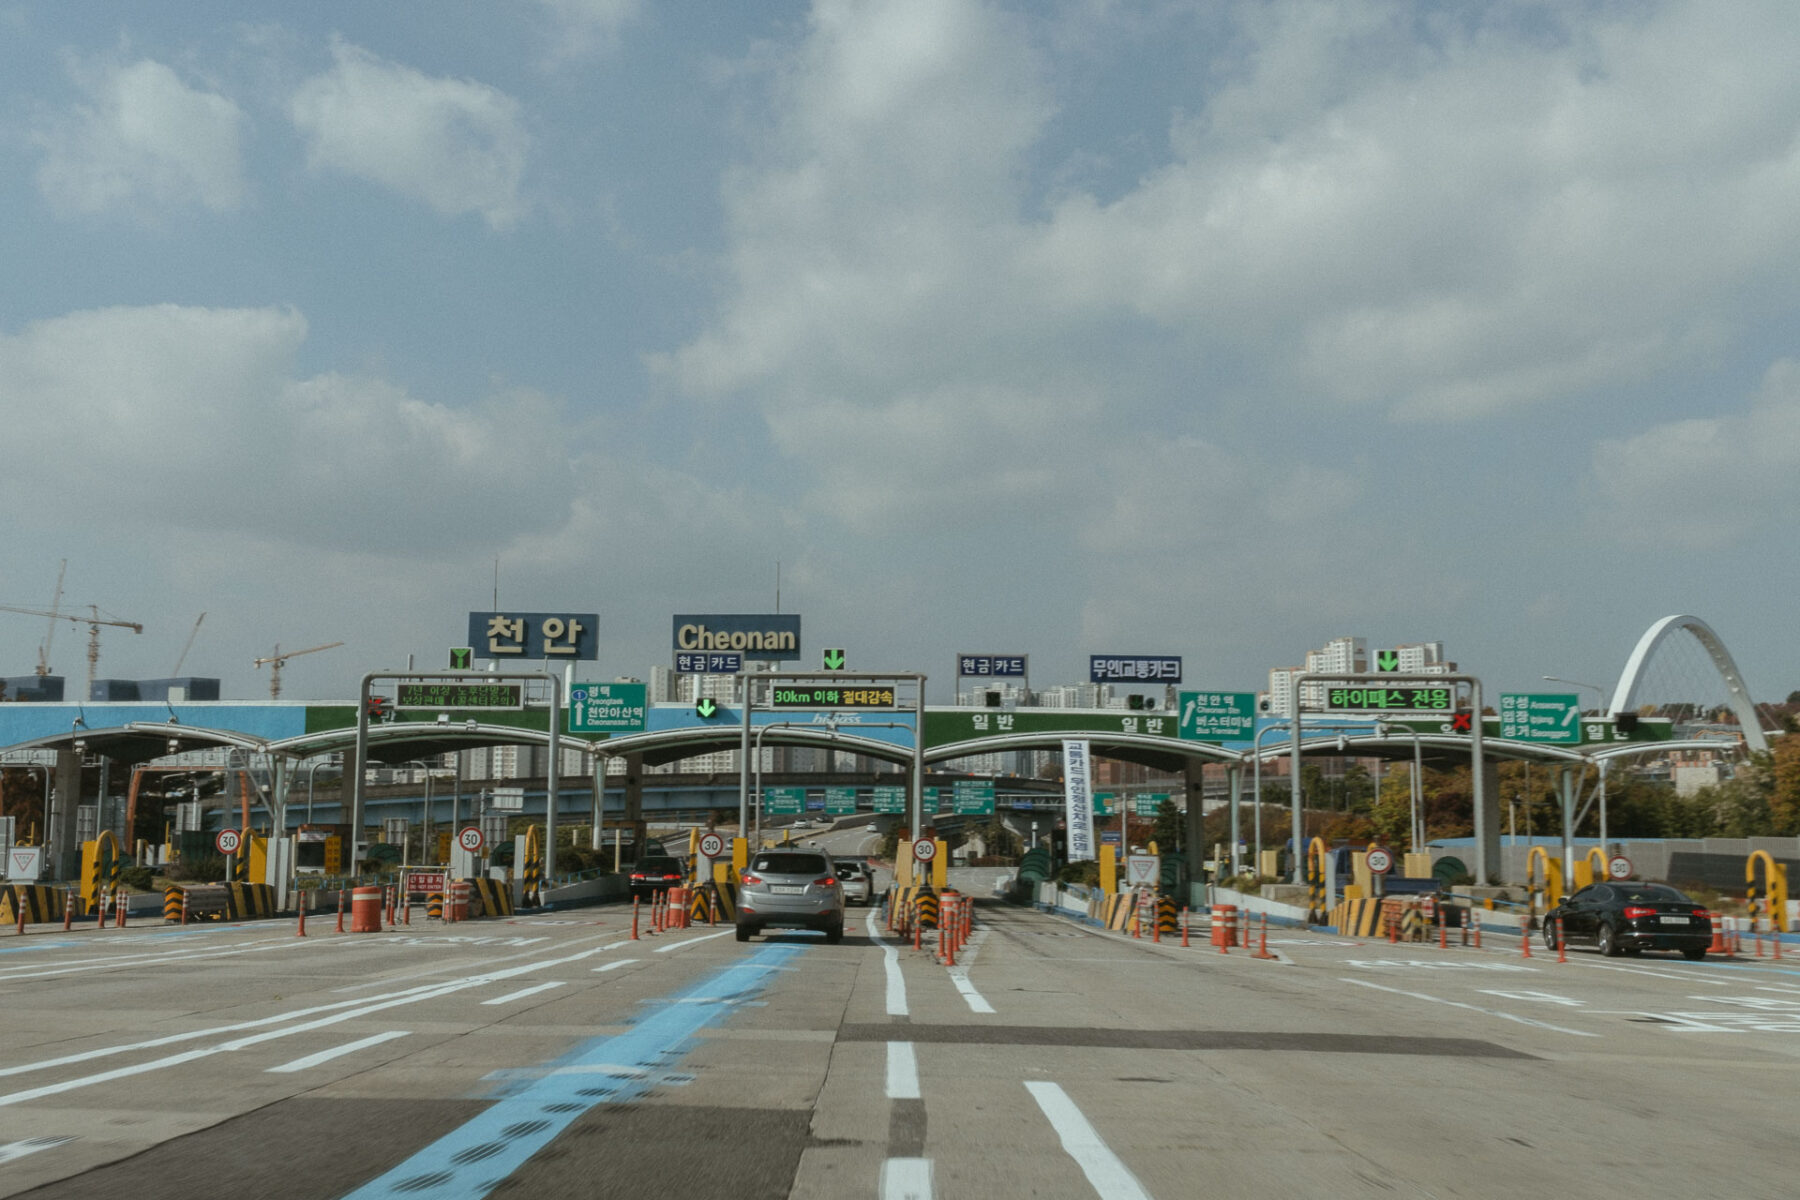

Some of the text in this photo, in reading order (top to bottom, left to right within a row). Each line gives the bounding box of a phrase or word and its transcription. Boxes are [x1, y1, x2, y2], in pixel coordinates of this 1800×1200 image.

[678, 624, 796, 650] Cheonan
[589, 686, 610, 697] 평택
[775, 690, 893, 704] 30km 이하 절대감속
[1331, 689, 1449, 708] 하이패스 전용
[1502, 696, 1528, 709] 안성
[588, 707, 643, 718] 천안아산역
[1196, 716, 1252, 727] 버스터미널
[223, 836, 235, 847] 30
[464, 834, 477, 845] 30
[704, 840, 718, 850] 30
[918, 845, 931, 855] 30
